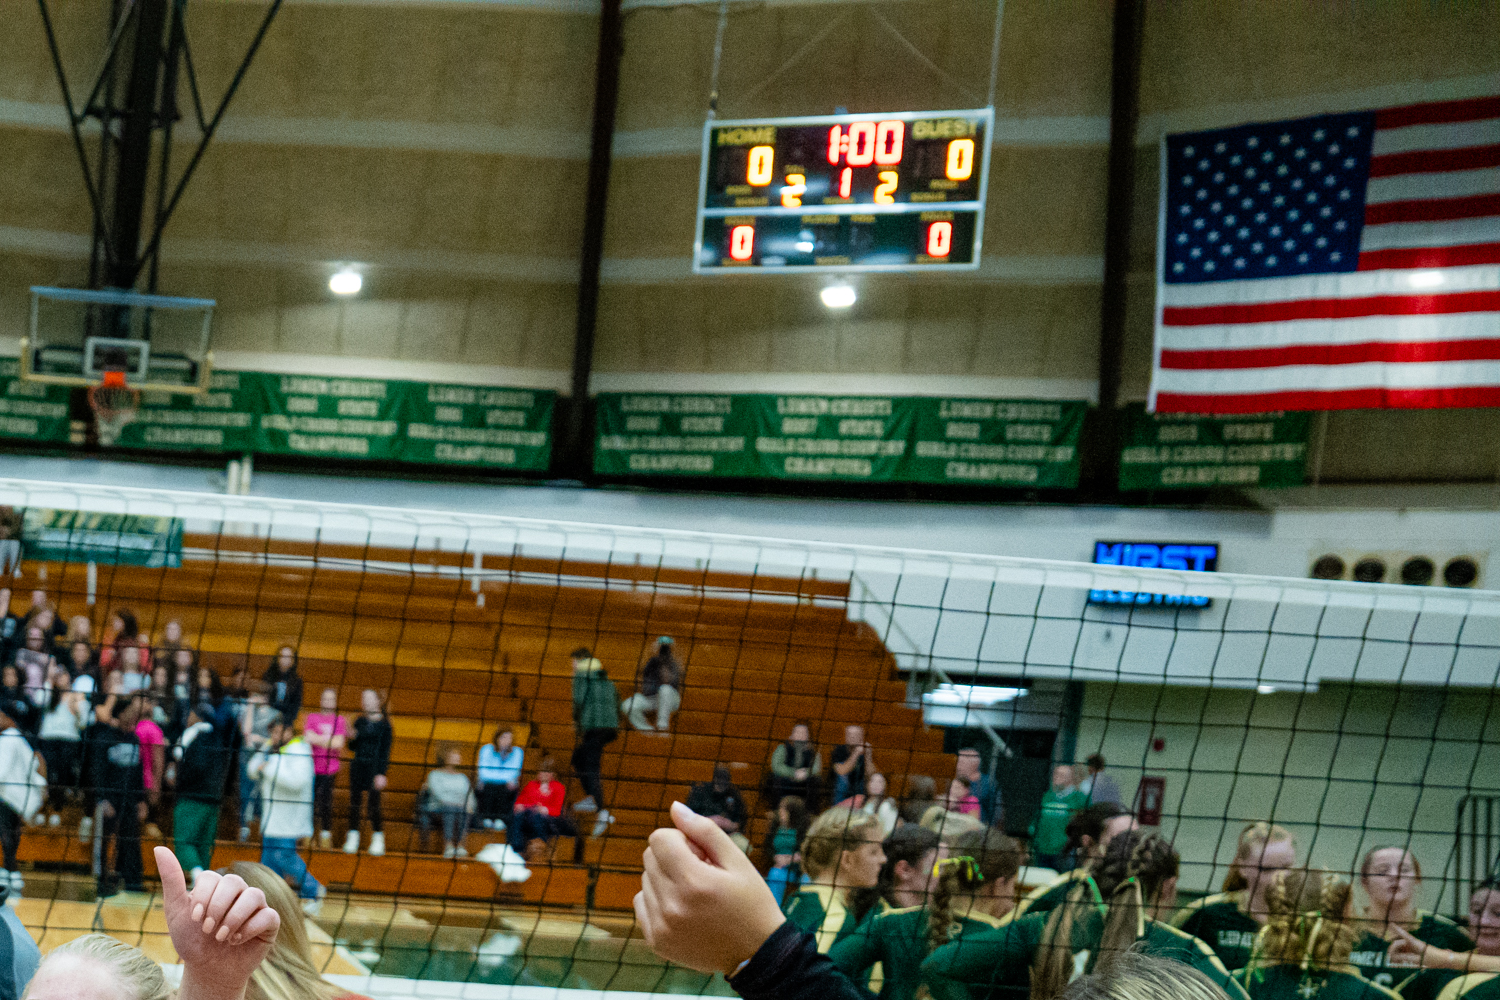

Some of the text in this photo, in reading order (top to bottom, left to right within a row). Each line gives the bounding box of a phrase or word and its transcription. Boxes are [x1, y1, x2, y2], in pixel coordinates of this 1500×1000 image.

[717, 127, 775, 146] HOME
[827, 120, 905, 166] 1:00
[912, 119, 977, 140] GUEST
[747, 145, 775, 186] 0
[946, 139, 975, 181] 0
[781, 173, 806, 208] 2
[838, 167, 852, 199] 1
[873, 171, 899, 205] 2
[730, 225, 755, 261] 0
[927, 221, 952, 258] 0
